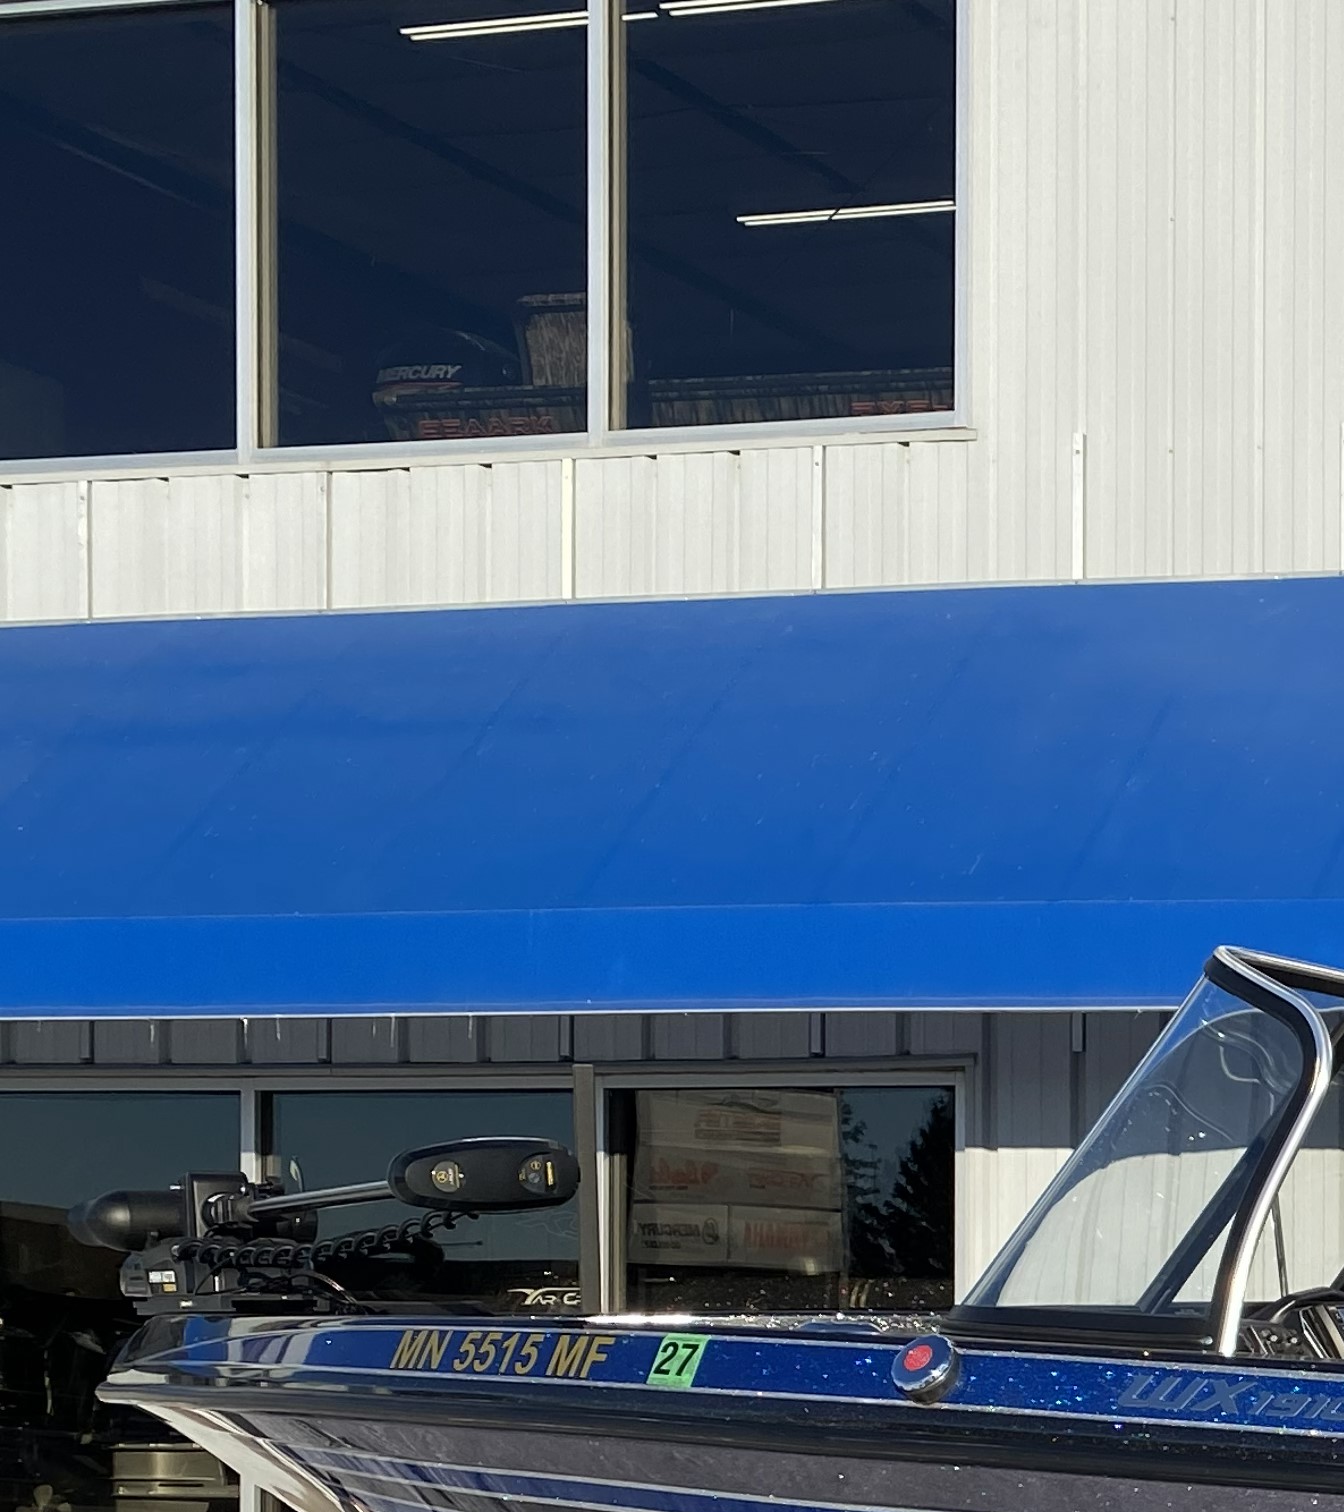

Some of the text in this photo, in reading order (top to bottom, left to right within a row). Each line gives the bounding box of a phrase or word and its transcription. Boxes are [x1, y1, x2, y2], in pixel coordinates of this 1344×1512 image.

[376, 365, 462, 384] MERCURY
[390, 1329, 617, 1379] MN 5515 MF
[653, 1341, 700, 1377] 27
